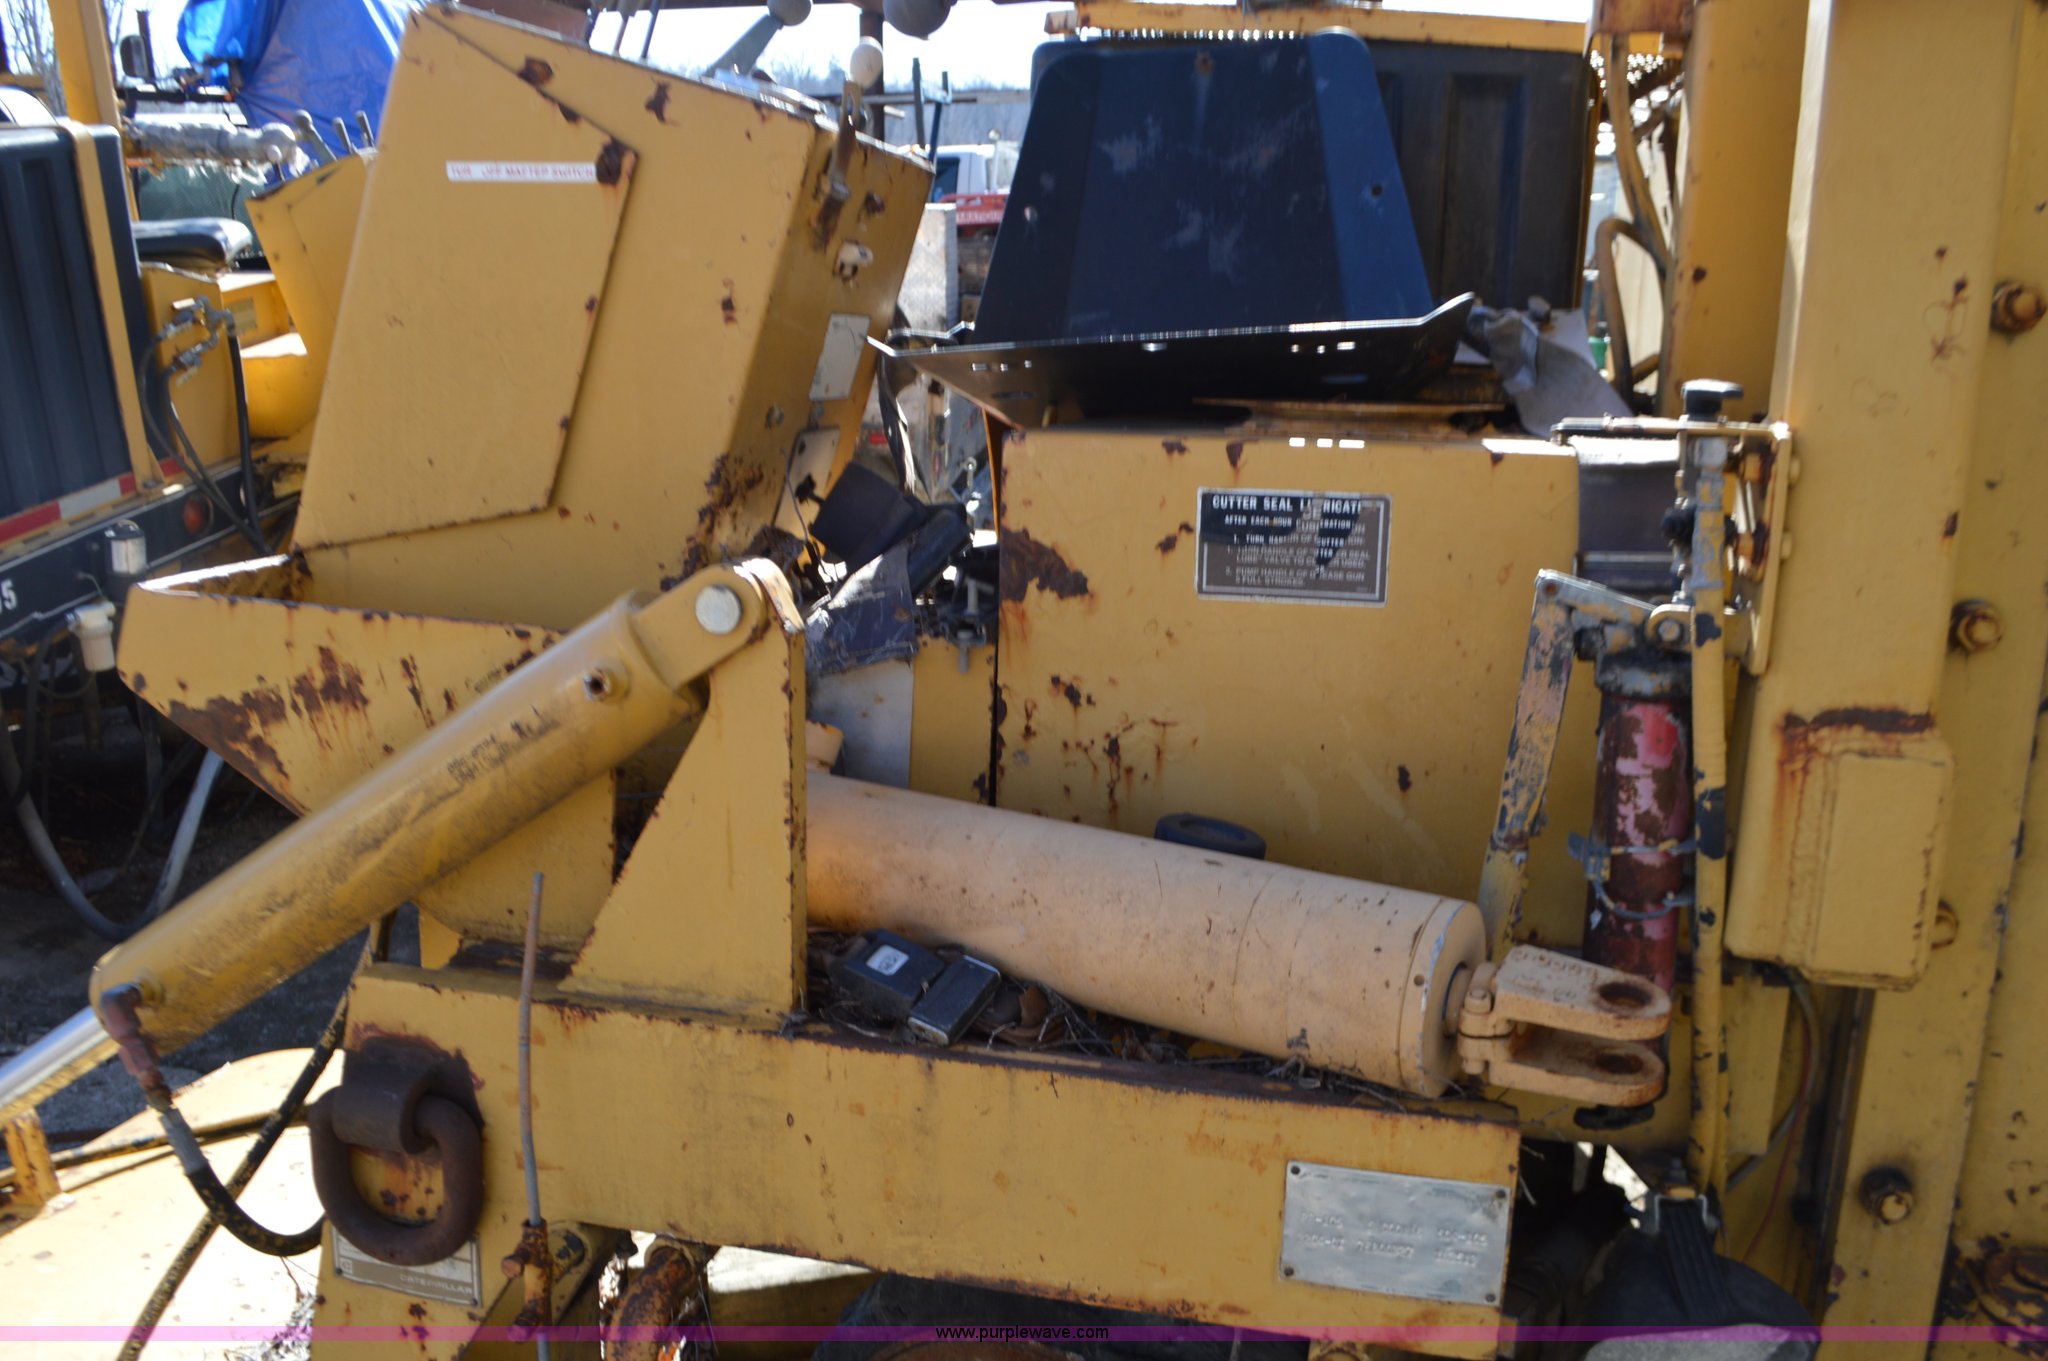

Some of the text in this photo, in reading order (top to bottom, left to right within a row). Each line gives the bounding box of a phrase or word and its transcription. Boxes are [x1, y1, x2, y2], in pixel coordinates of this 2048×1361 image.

[1212, 495, 1258, 511] CUTTER
[1263, 497, 1294, 512] SEAL
[1224, 514, 1248, 525] AFTER
[1251, 516, 1270, 526] EACH
[399, 1273, 474, 1295] CATERPILLAR
